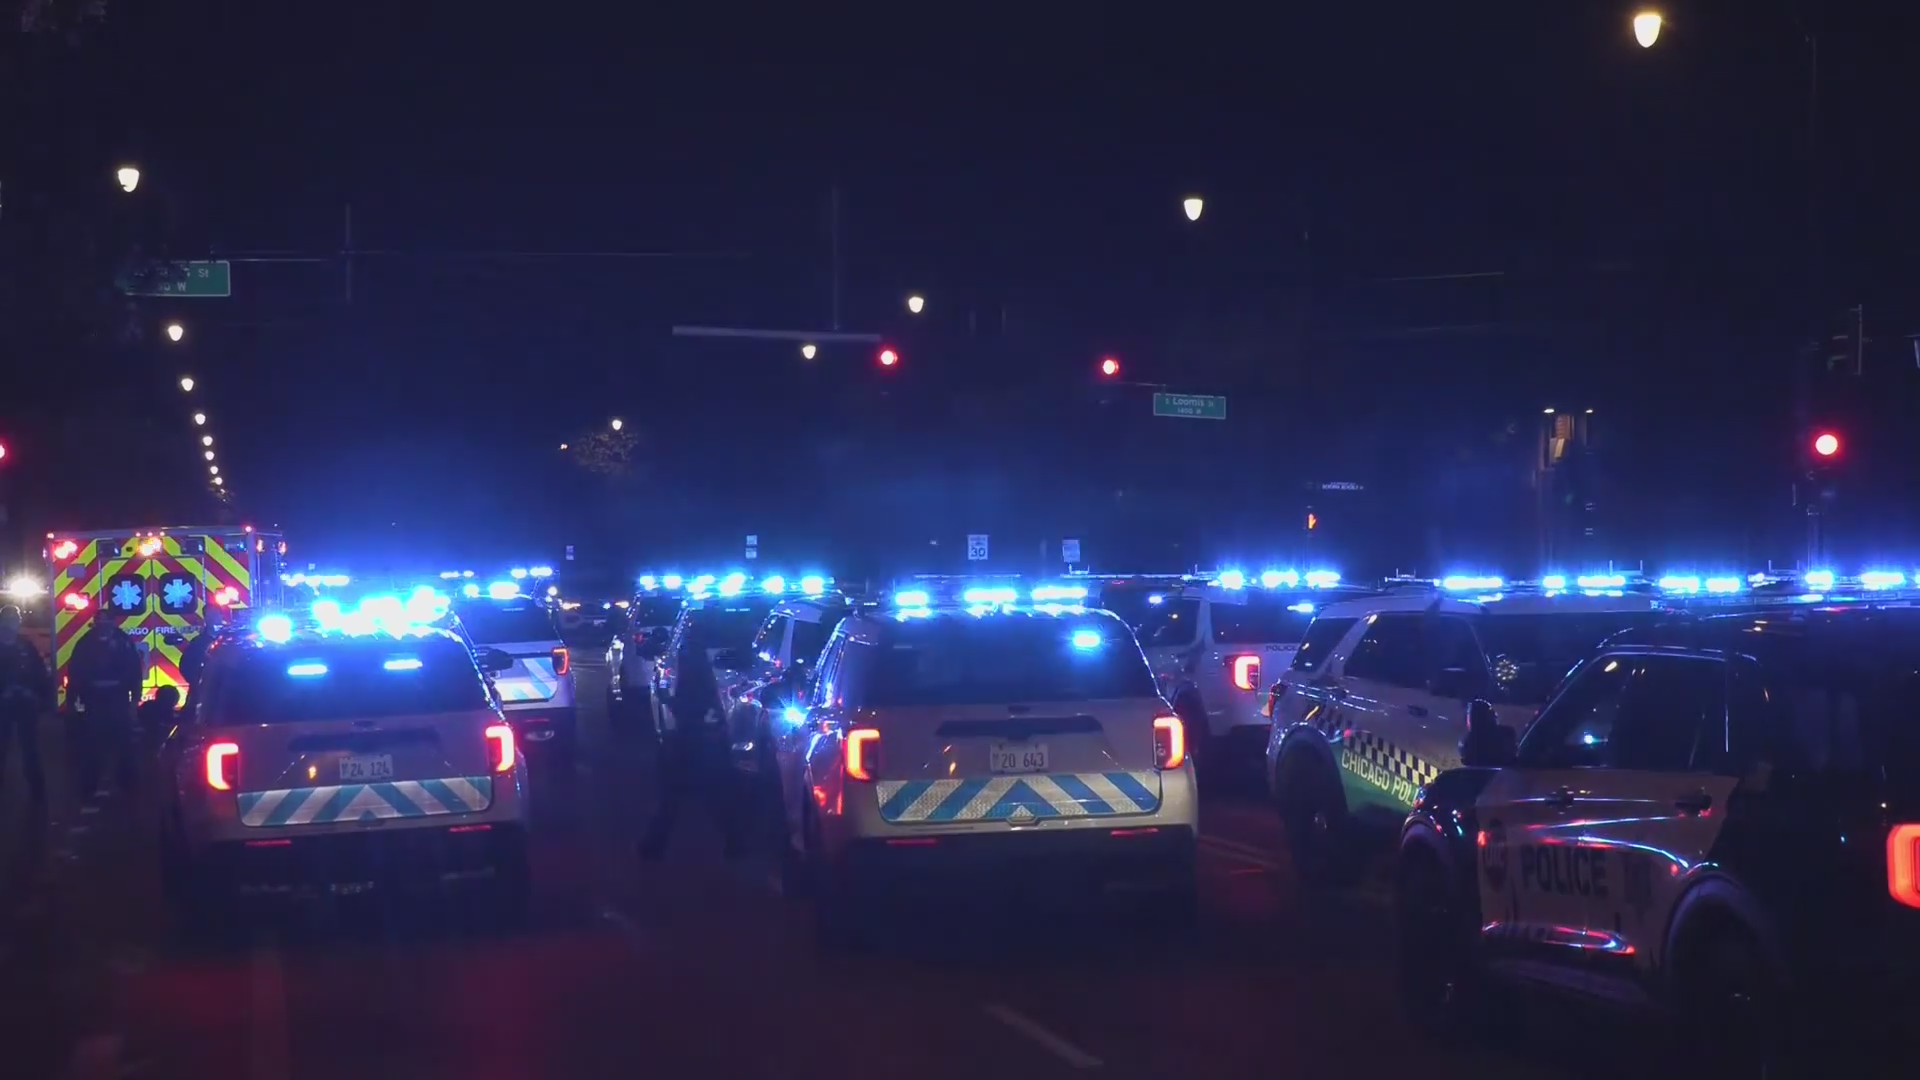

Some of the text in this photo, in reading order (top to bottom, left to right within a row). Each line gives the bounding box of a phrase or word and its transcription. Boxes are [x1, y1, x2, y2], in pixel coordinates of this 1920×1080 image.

[1172, 397, 1205, 408] Loomis
[971, 547, 986, 557] 30
[155, 626, 176, 634] FIRE
[1001, 752, 1016, 769] 20
[1023, 752, 1044, 768] 643
[1341, 748, 1419, 807] CHICAGO POLI
[1520, 845, 1609, 898] POLICE
